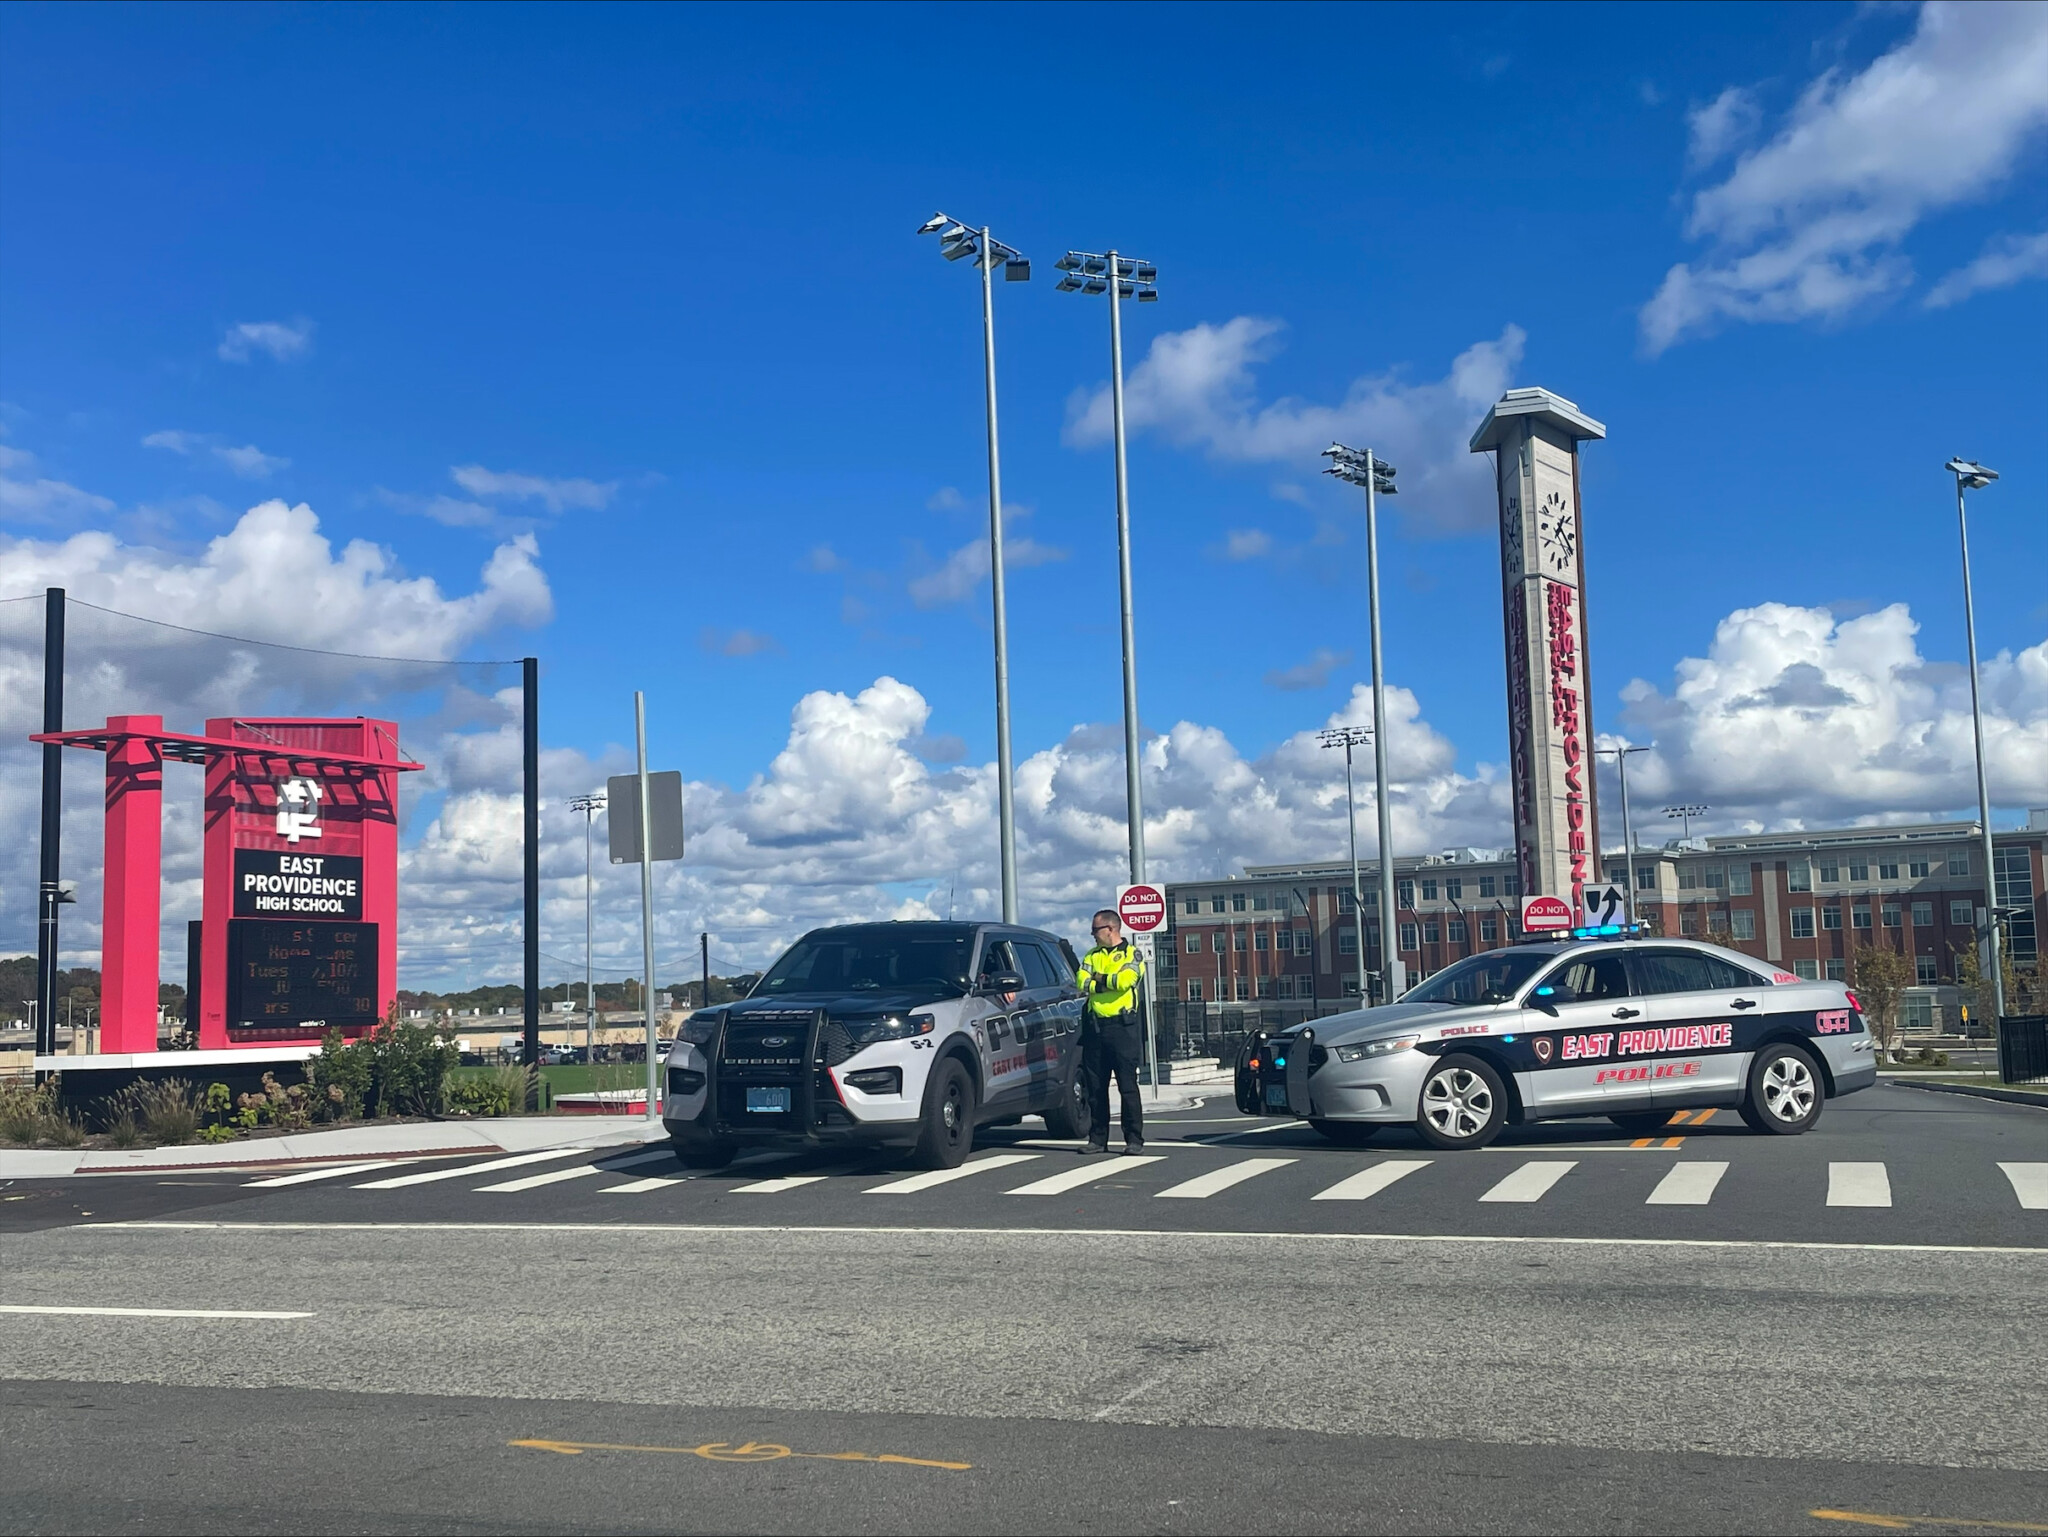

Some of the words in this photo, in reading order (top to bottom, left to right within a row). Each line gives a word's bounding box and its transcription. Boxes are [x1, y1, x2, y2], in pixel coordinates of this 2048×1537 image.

[1558, 584, 1576, 682] EAST
[1550, 638, 1564, 731] SCHOOL
[280, 856, 324, 875] EAST
[244, 874, 356, 896] PROVIDENCE
[256, 896, 290, 910] HIGH
[292, 898, 345, 912] SCHOOL
[1124, 894, 1137, 903] DO
[1140, 893, 1157, 902] NOT
[1530, 906, 1543, 914] DO
[1547, 906, 1565, 914] NOT
[1129, 915, 1156, 925] ENTER
[1440, 1025, 1489, 1037] POLICE
[910, 1038, 935, 1050] S-2
[1561, 1033, 1613, 1061] EAST
[1617, 1023, 1733, 1055] PROVIDENCE
[1593, 1061, 1702, 1086] POLICE
